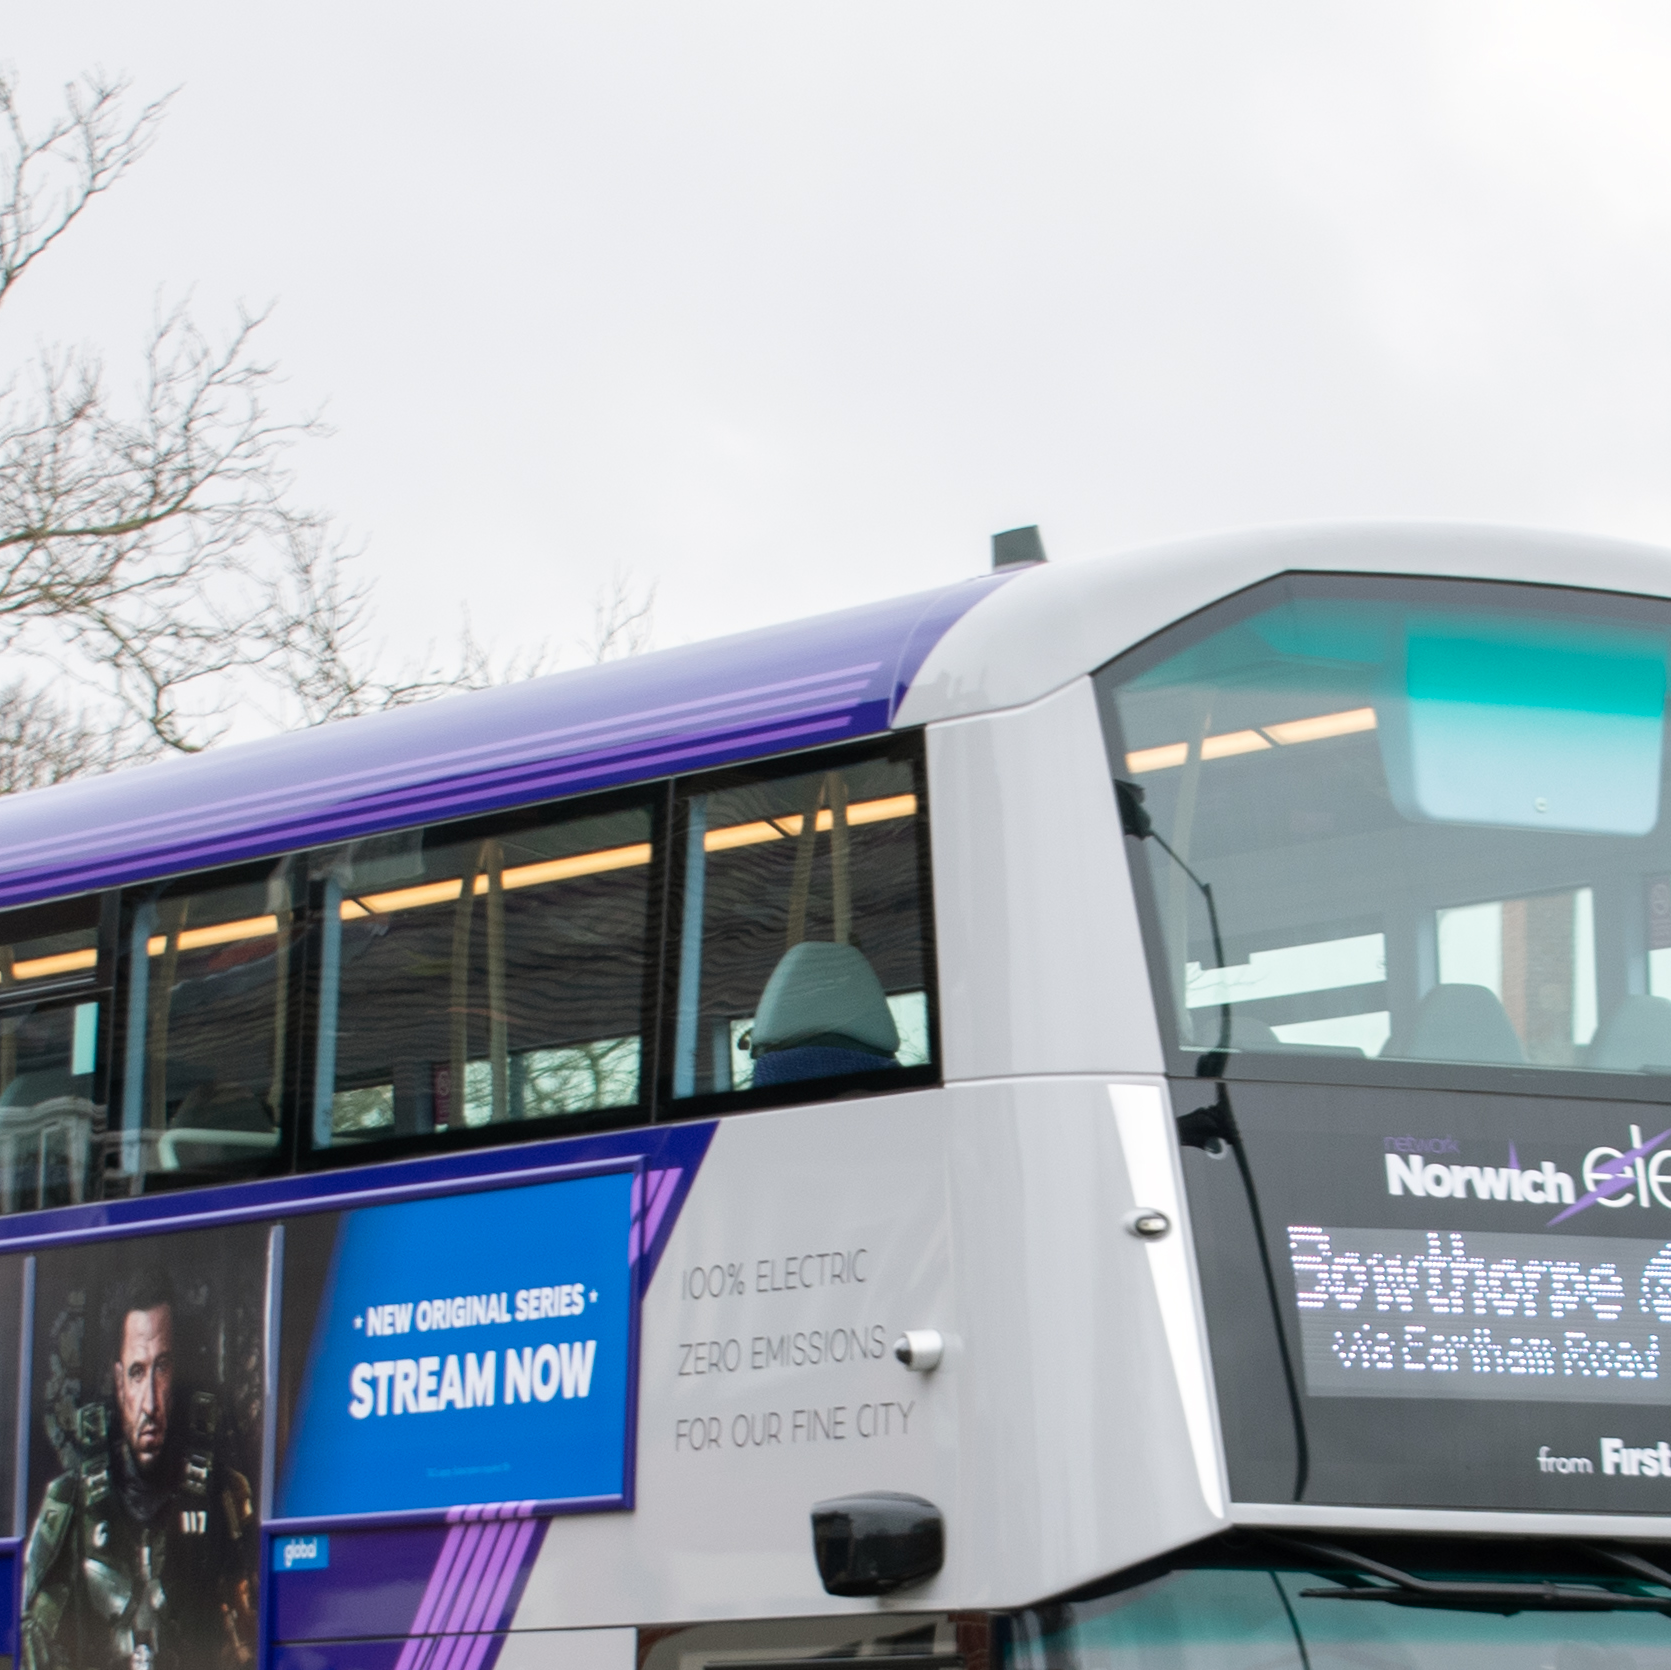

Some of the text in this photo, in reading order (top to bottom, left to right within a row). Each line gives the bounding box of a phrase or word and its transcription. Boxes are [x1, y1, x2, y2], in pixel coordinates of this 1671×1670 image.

[1384, 1153, 1576, 1205] Norwich
[682, 1247, 869, 1301] 100% ELECTRIC
[1287, 1225, 1625, 1320] Bowthorpe
[366, 1282, 586, 1338] NEW ORIGINAL SERIES
[677, 1324, 887, 1378] ZERO EMISSIONS
[1332, 1323, 1394, 1369] via
[1563, 1332, 1661, 1379] Road
[349, 1340, 597, 1420] STREAM NOW
[675, 1401, 916, 1453] FOR OUR FINE CITY
[1536, 1445, 1594, 1474] from
[283, 1536, 318, 1568] global
